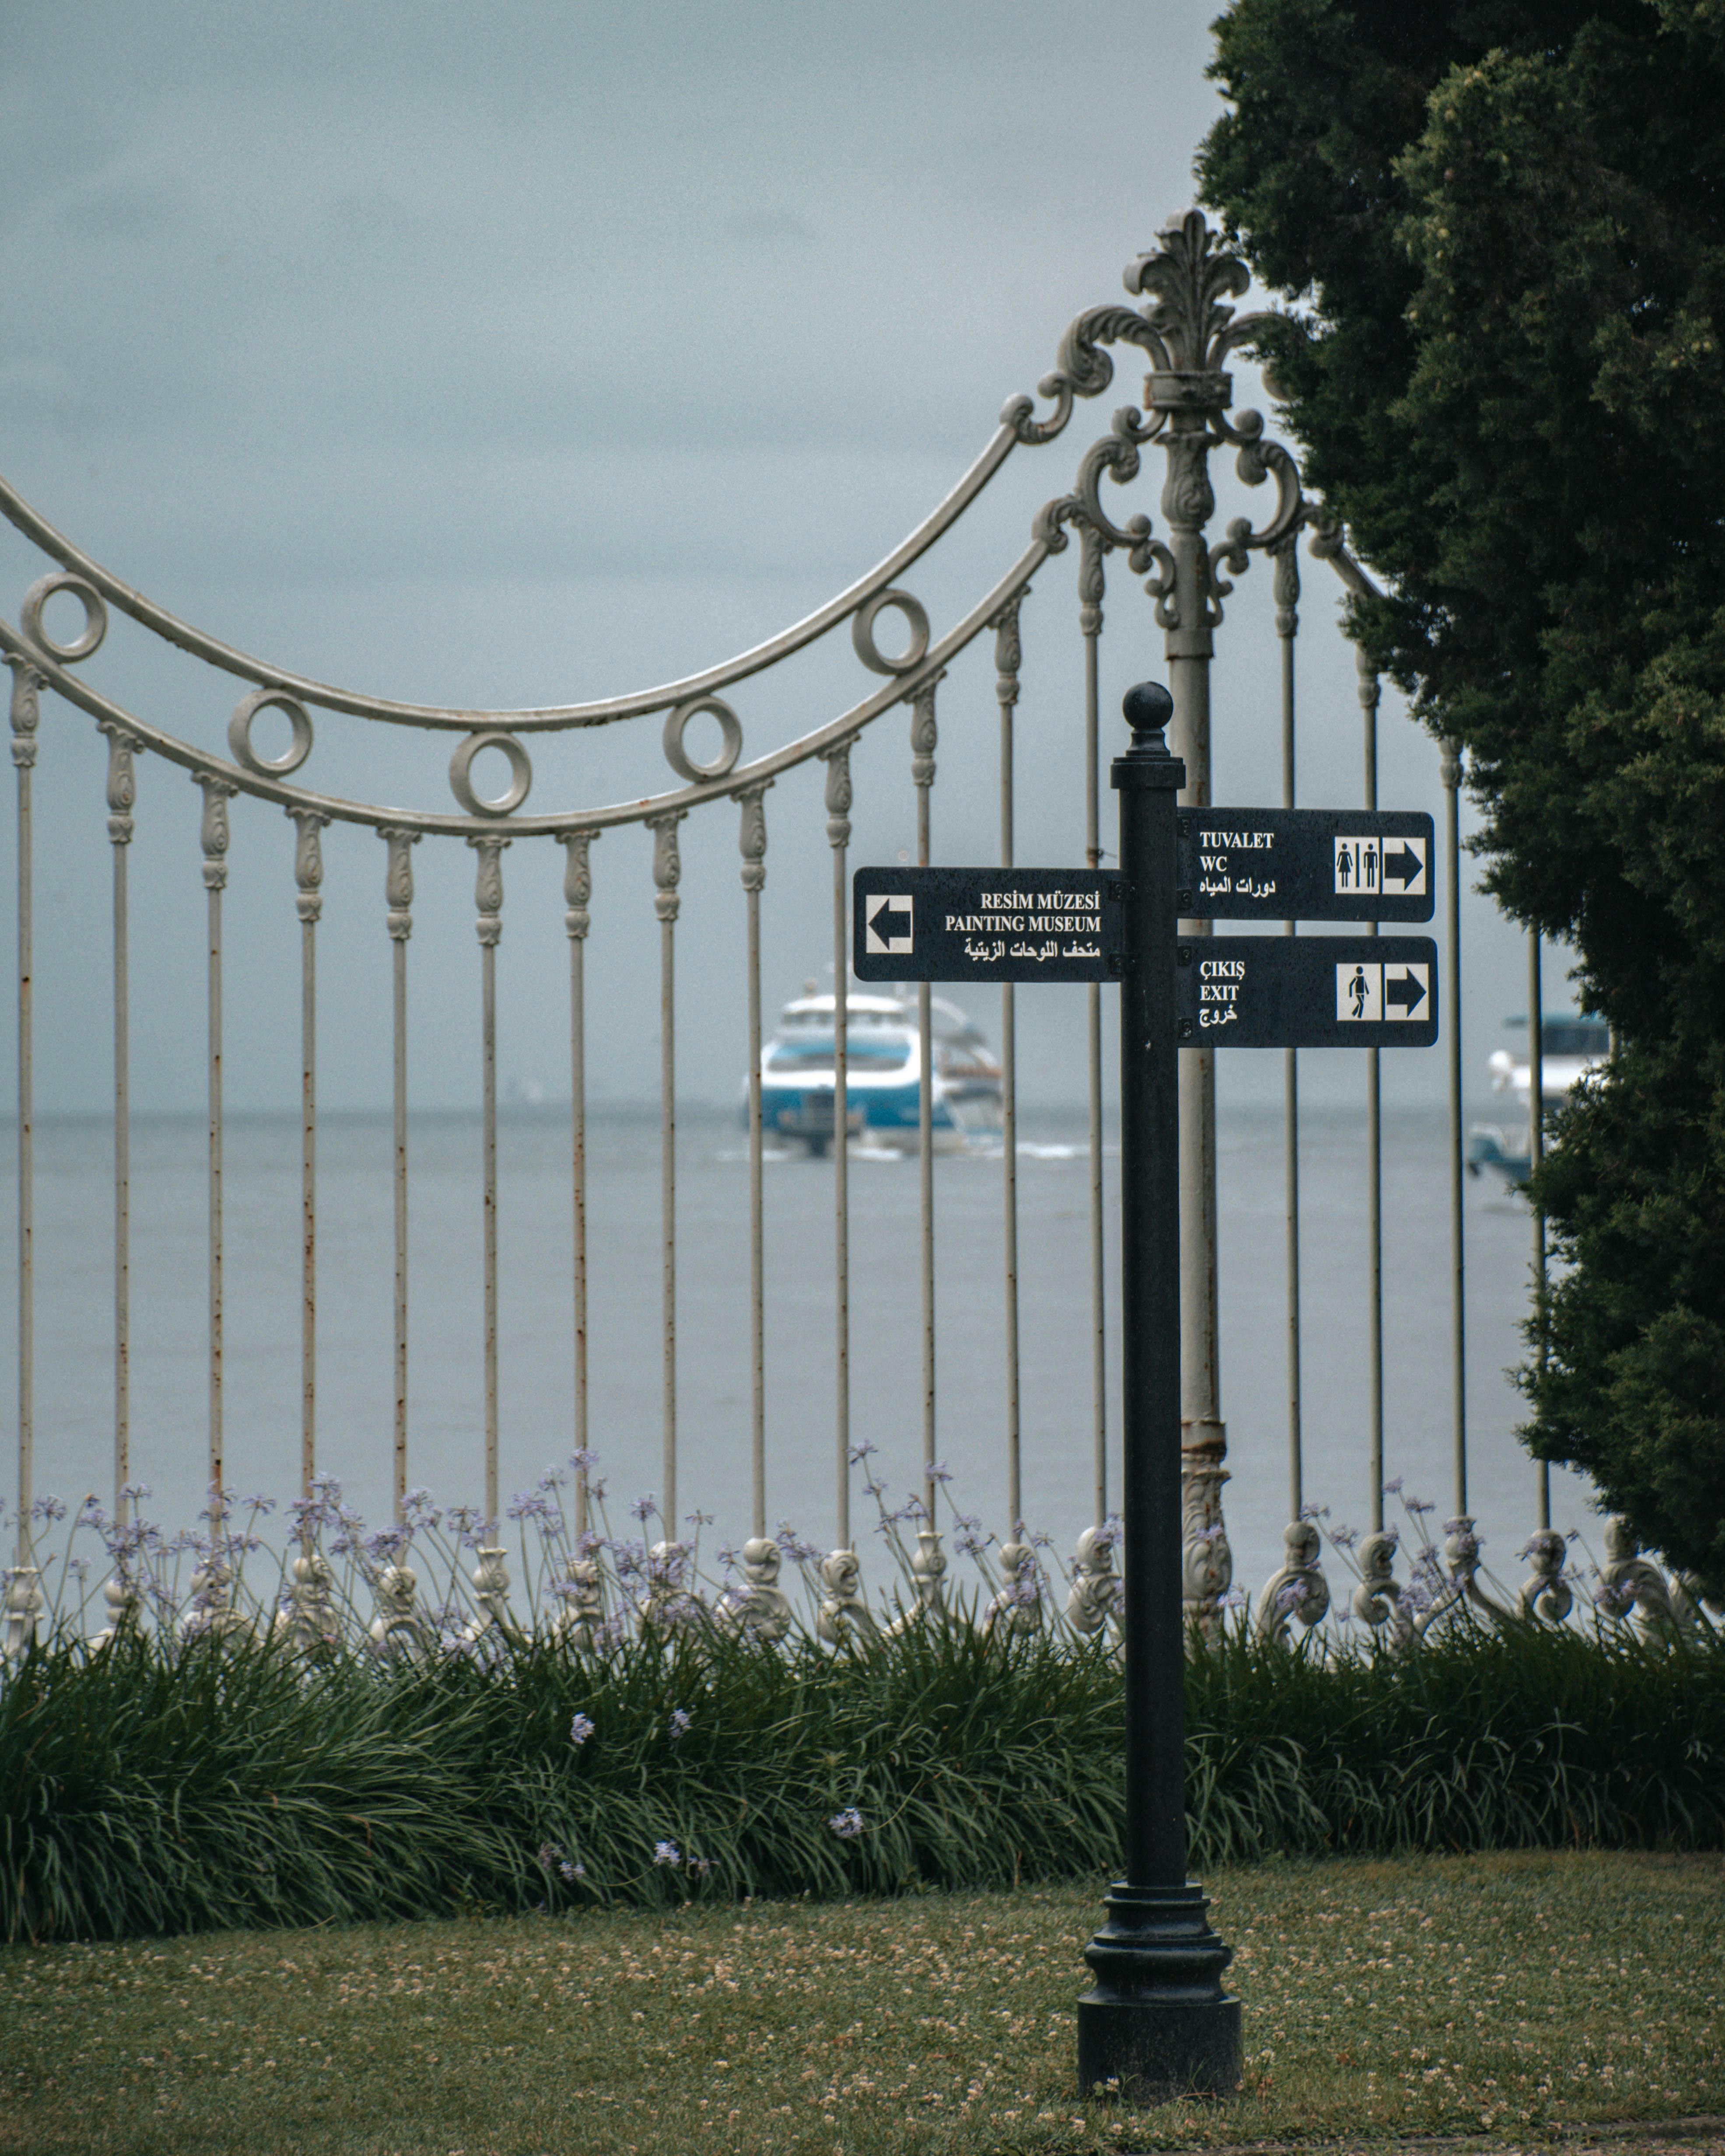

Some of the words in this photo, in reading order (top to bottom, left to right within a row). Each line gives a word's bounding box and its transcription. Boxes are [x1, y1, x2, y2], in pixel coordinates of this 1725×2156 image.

[1199, 831, 1274, 848] TUVALET
[1199, 856, 1227, 872] WC
[1199, 876, 1231, 897] المياه
[1235, 877, 1276, 897] دورات
[980, 890, 1034, 909] RESİM
[1037, 890, 1101, 910] MÜZESİ
[945, 915, 1025, 932] PAINTING
[1028, 916, 1101, 932] MUSEUM
[964, 937, 1005, 961] الزيتية
[1010, 940, 1058, 962] اللوحات
[1062, 940, 1101, 957] متحف
[1200, 961, 1245, 980] ÇIKIŞ
[1200, 985, 1239, 1001] EXIT
[1199, 1004, 1238, 1027] خروج
